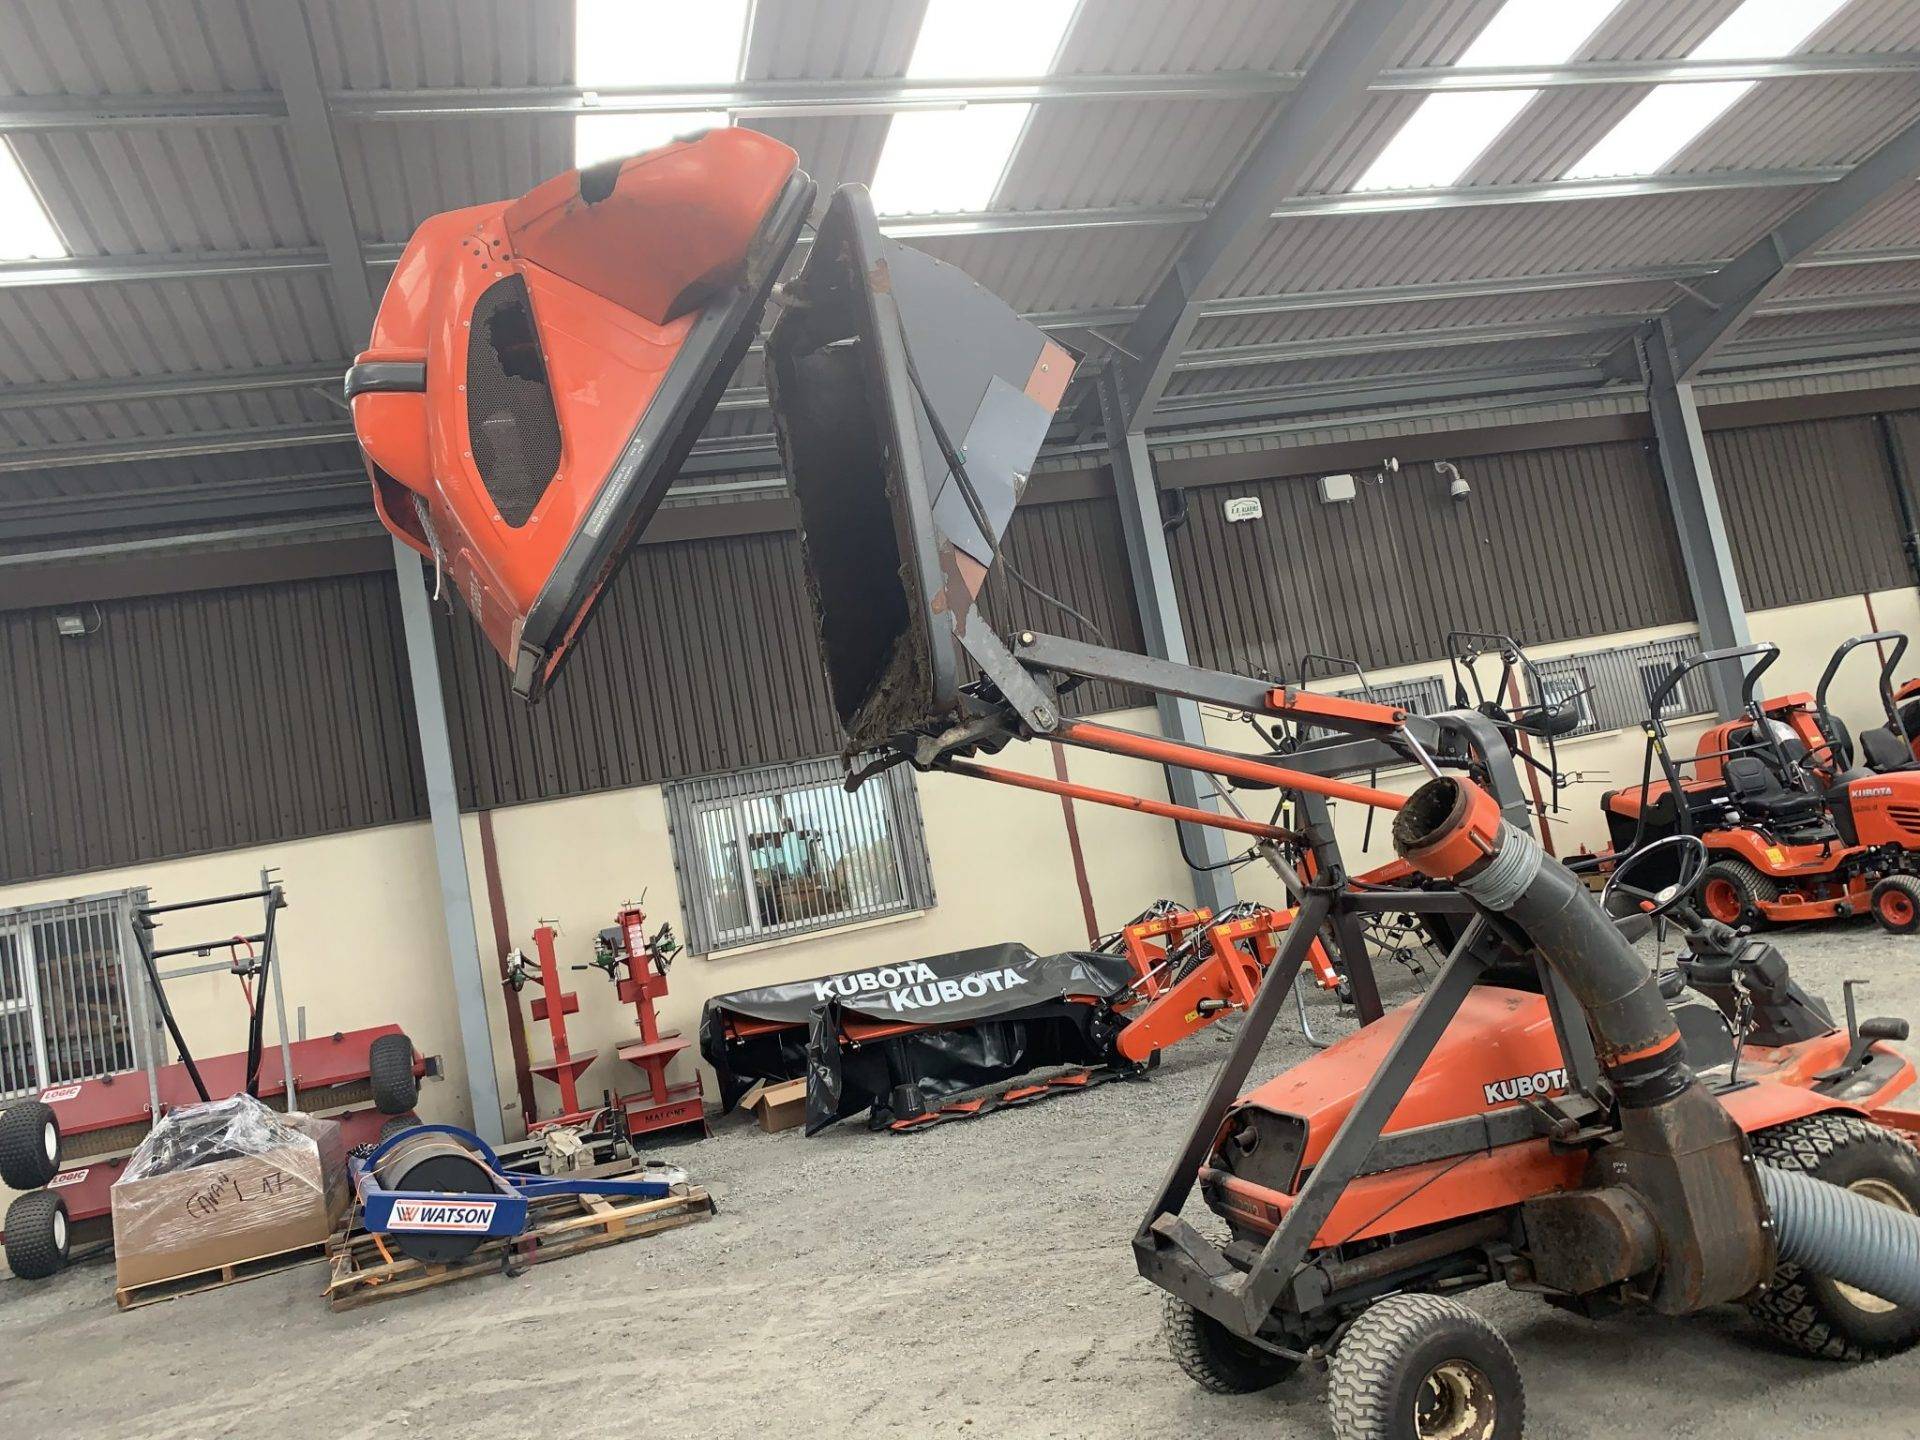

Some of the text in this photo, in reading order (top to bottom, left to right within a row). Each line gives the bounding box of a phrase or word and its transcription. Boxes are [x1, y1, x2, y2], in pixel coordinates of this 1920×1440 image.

[1851, 787, 1893, 797] KUBOTA
[814, 962, 938, 1002] KUBOTA
[889, 967, 1029, 1012] KUBOTA
[45, 1087, 79, 1100] LOGIC
[52, 1171, 87, 1184] LOGIC
[420, 1207, 491, 1224] WATSON
